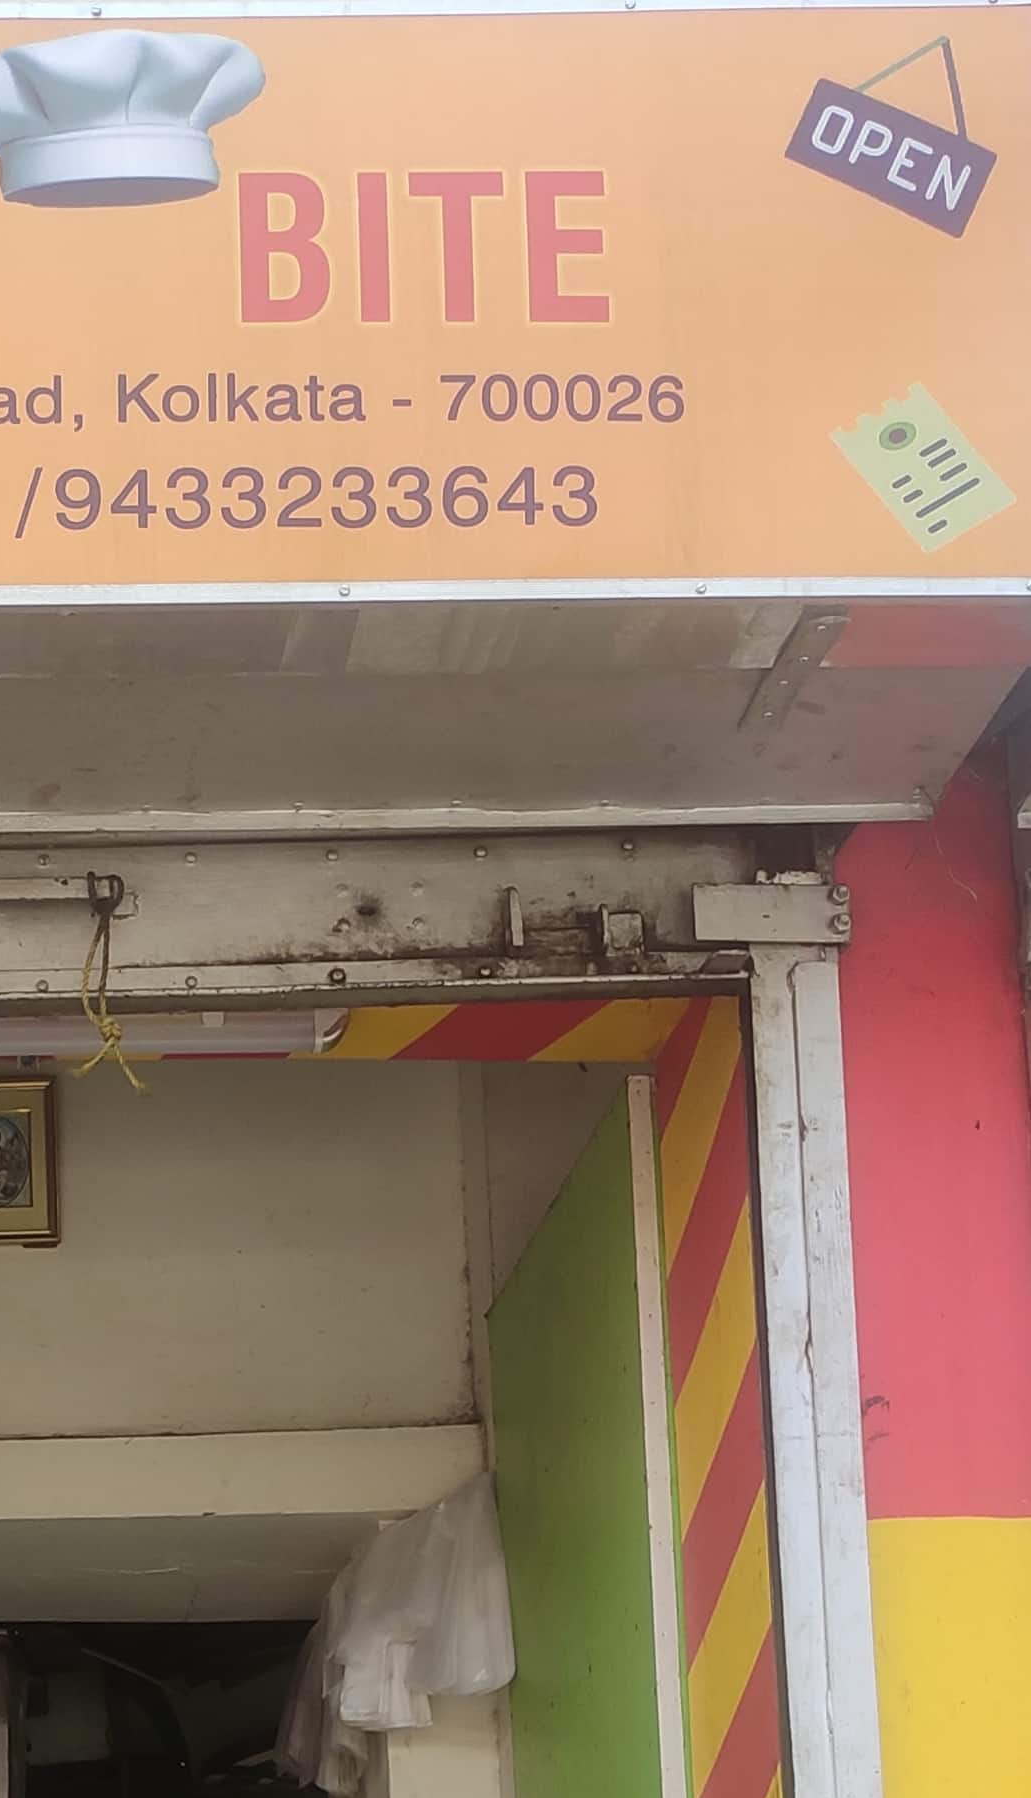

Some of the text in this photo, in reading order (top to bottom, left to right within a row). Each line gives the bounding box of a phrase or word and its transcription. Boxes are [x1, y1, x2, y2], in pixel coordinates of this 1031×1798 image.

[811, 104, 970, 212] OPEN
[237, 170, 611, 324] BITE
[117, 372, 367, 425] Kolkata
[439, 373, 685, 424] 700026
[15, 464, 599, 539] /9433233643
